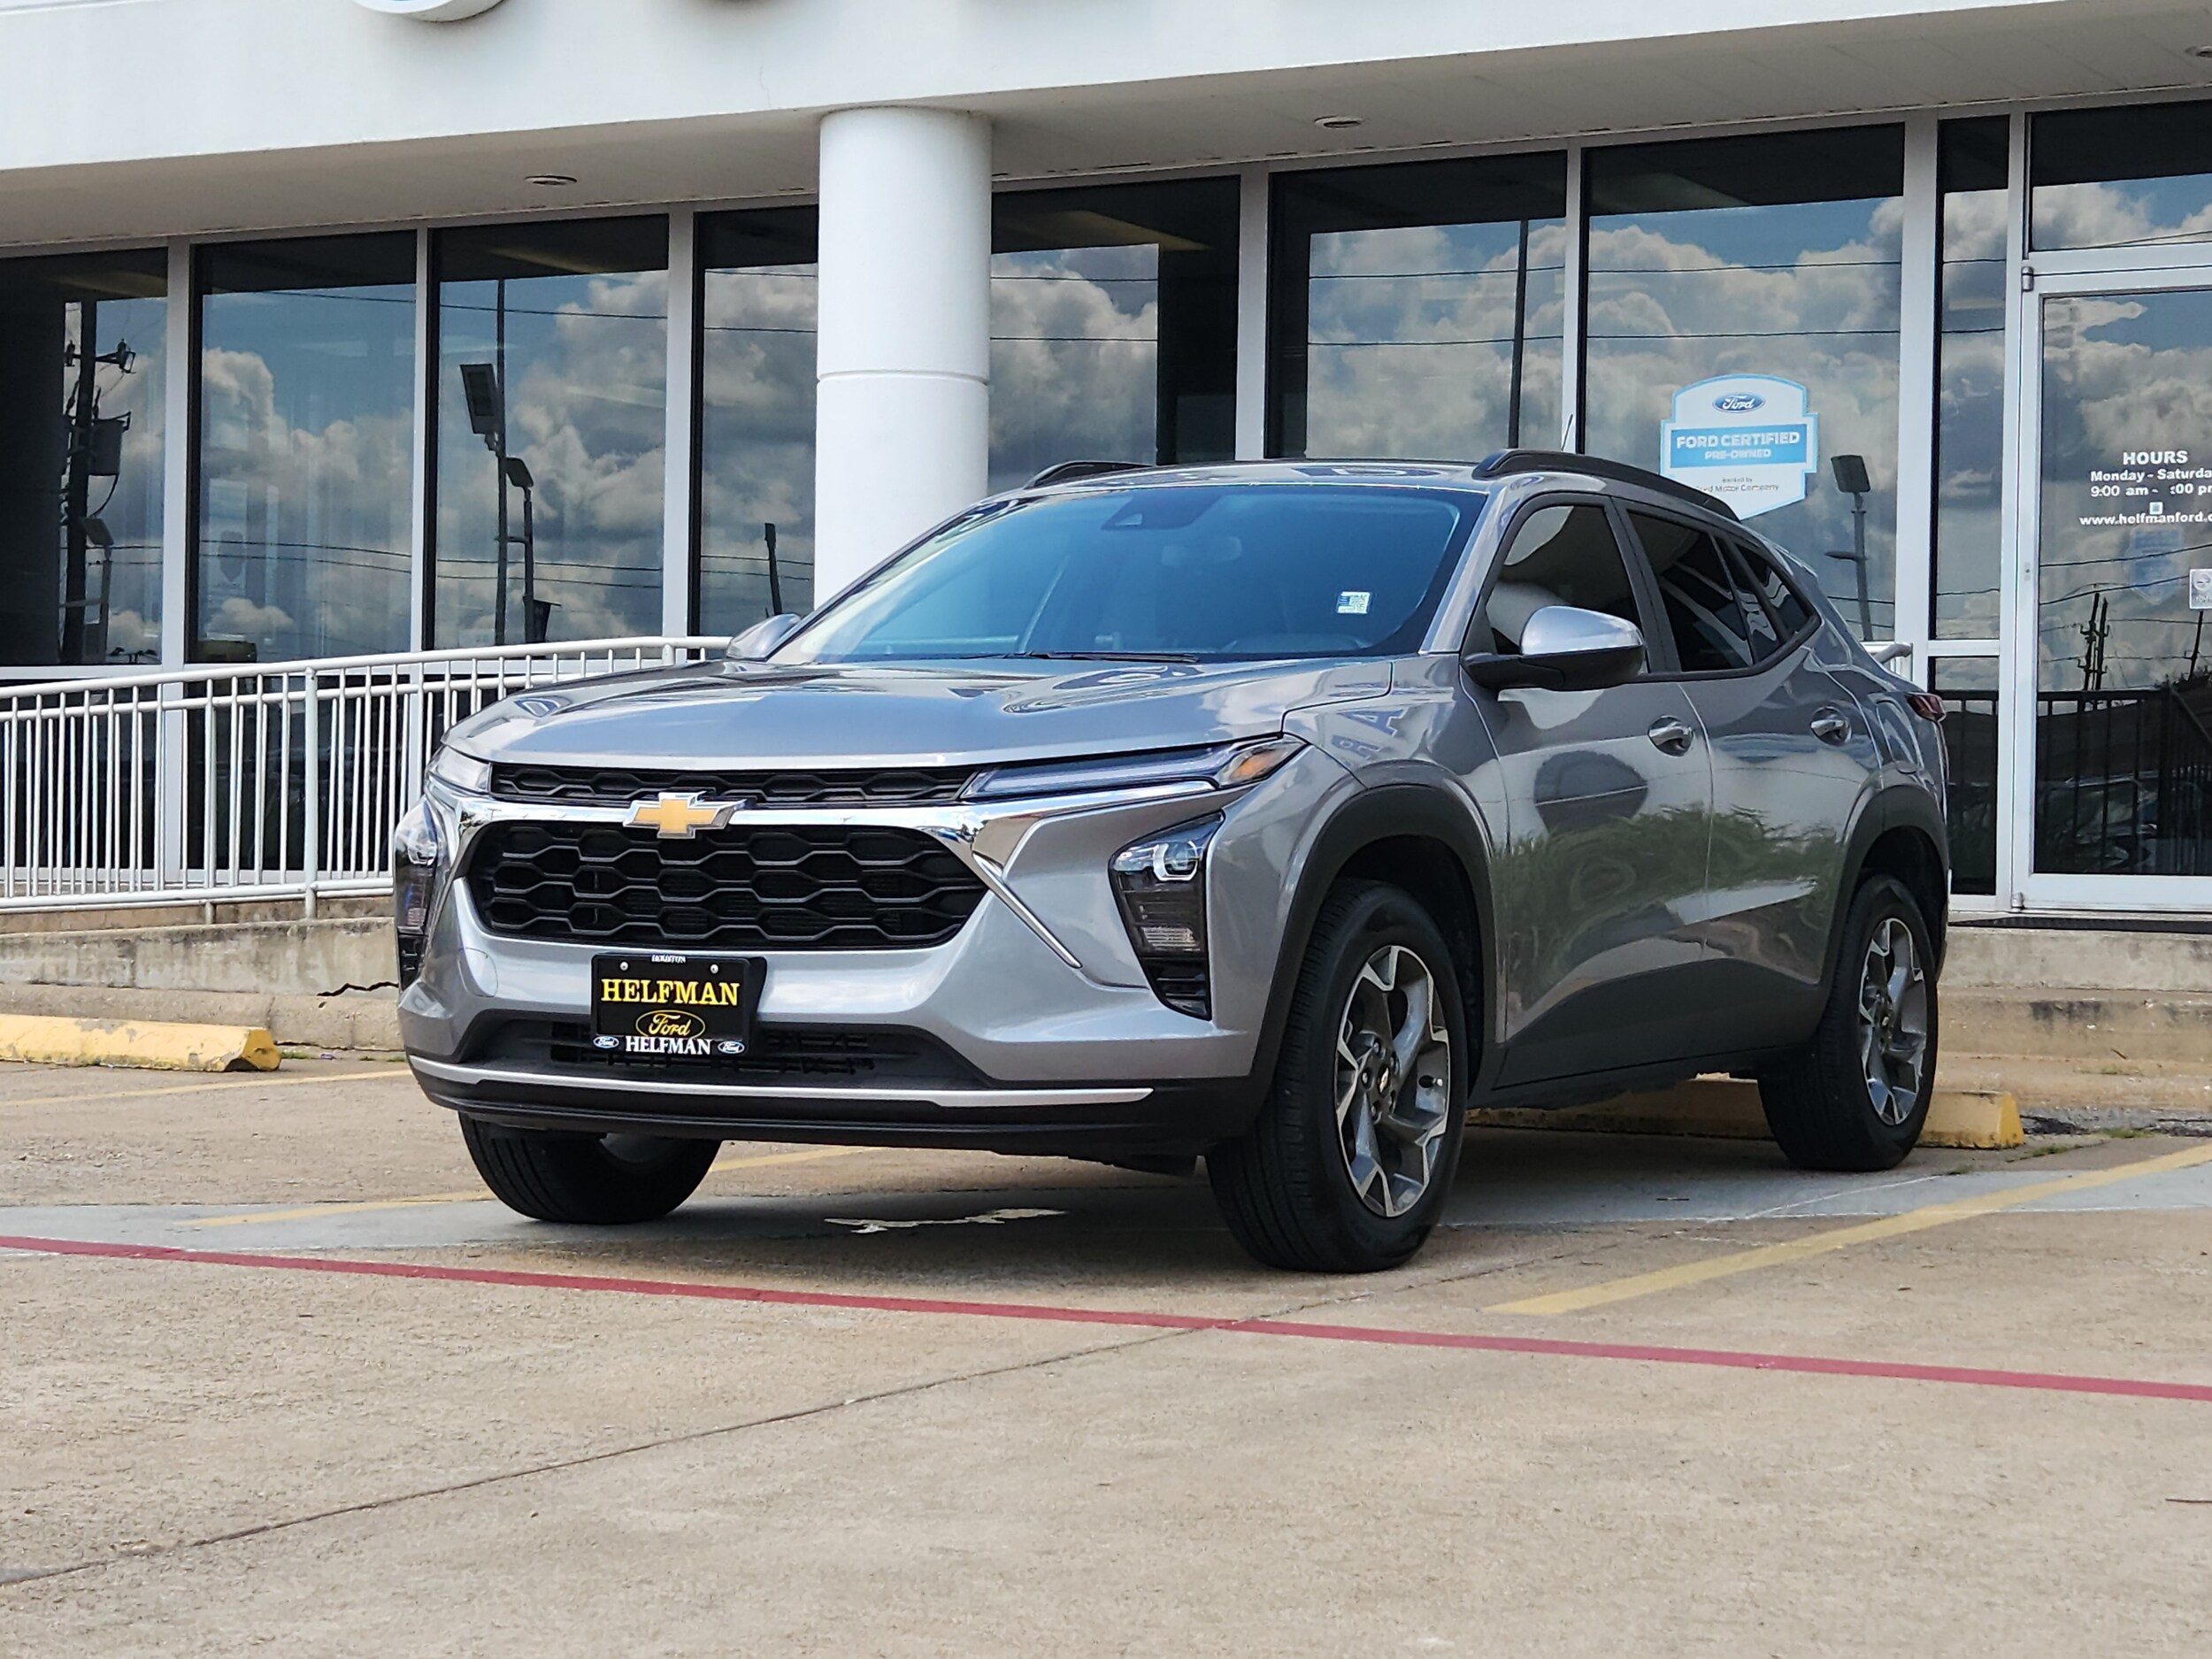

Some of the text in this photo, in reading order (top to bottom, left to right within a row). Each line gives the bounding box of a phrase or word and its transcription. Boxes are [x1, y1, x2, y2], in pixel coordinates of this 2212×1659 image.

[1722, 396, 1755, 410] Ford
[1677, 431, 1801, 449] FORD CERTIFIED
[1704, 448, 1772, 460] PRE-OWNED
[2123, 450, 2188, 465] HOURS
[2090, 470, 2146, 482] Monday
[2090, 485, 2121, 497] 9:00
[2125, 488, 2149, 496] am
[601, 979, 740, 1006] HELFMAN
[648, 1013, 691, 1036] Ford
[625, 1035, 712, 1056] HELFMAN
